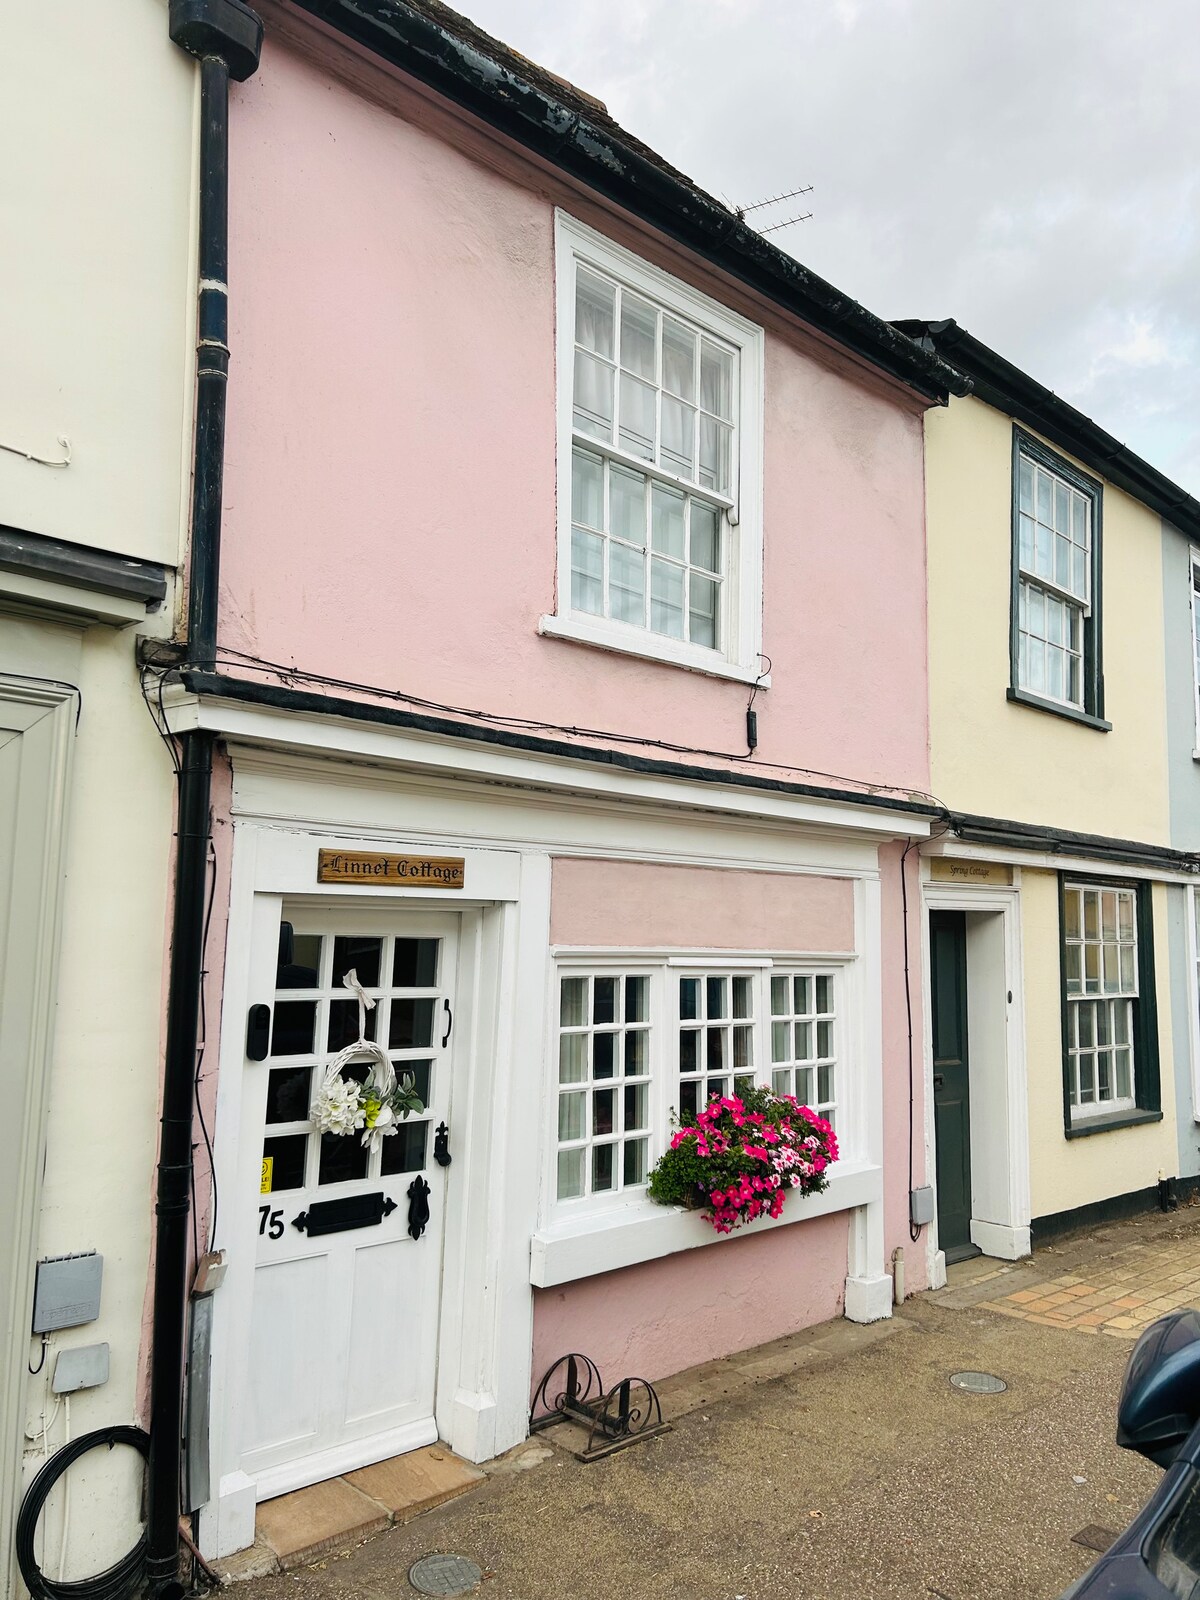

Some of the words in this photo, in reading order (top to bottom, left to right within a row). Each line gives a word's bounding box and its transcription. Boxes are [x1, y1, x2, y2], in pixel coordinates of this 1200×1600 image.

[330, 854, 389, 876] Linnet
[397, 860, 459, 882] Cottage
[950, 865, 968, 877] Spring
[969, 866, 990, 879] Cottage
[259, 1205, 284, 1240] 75
